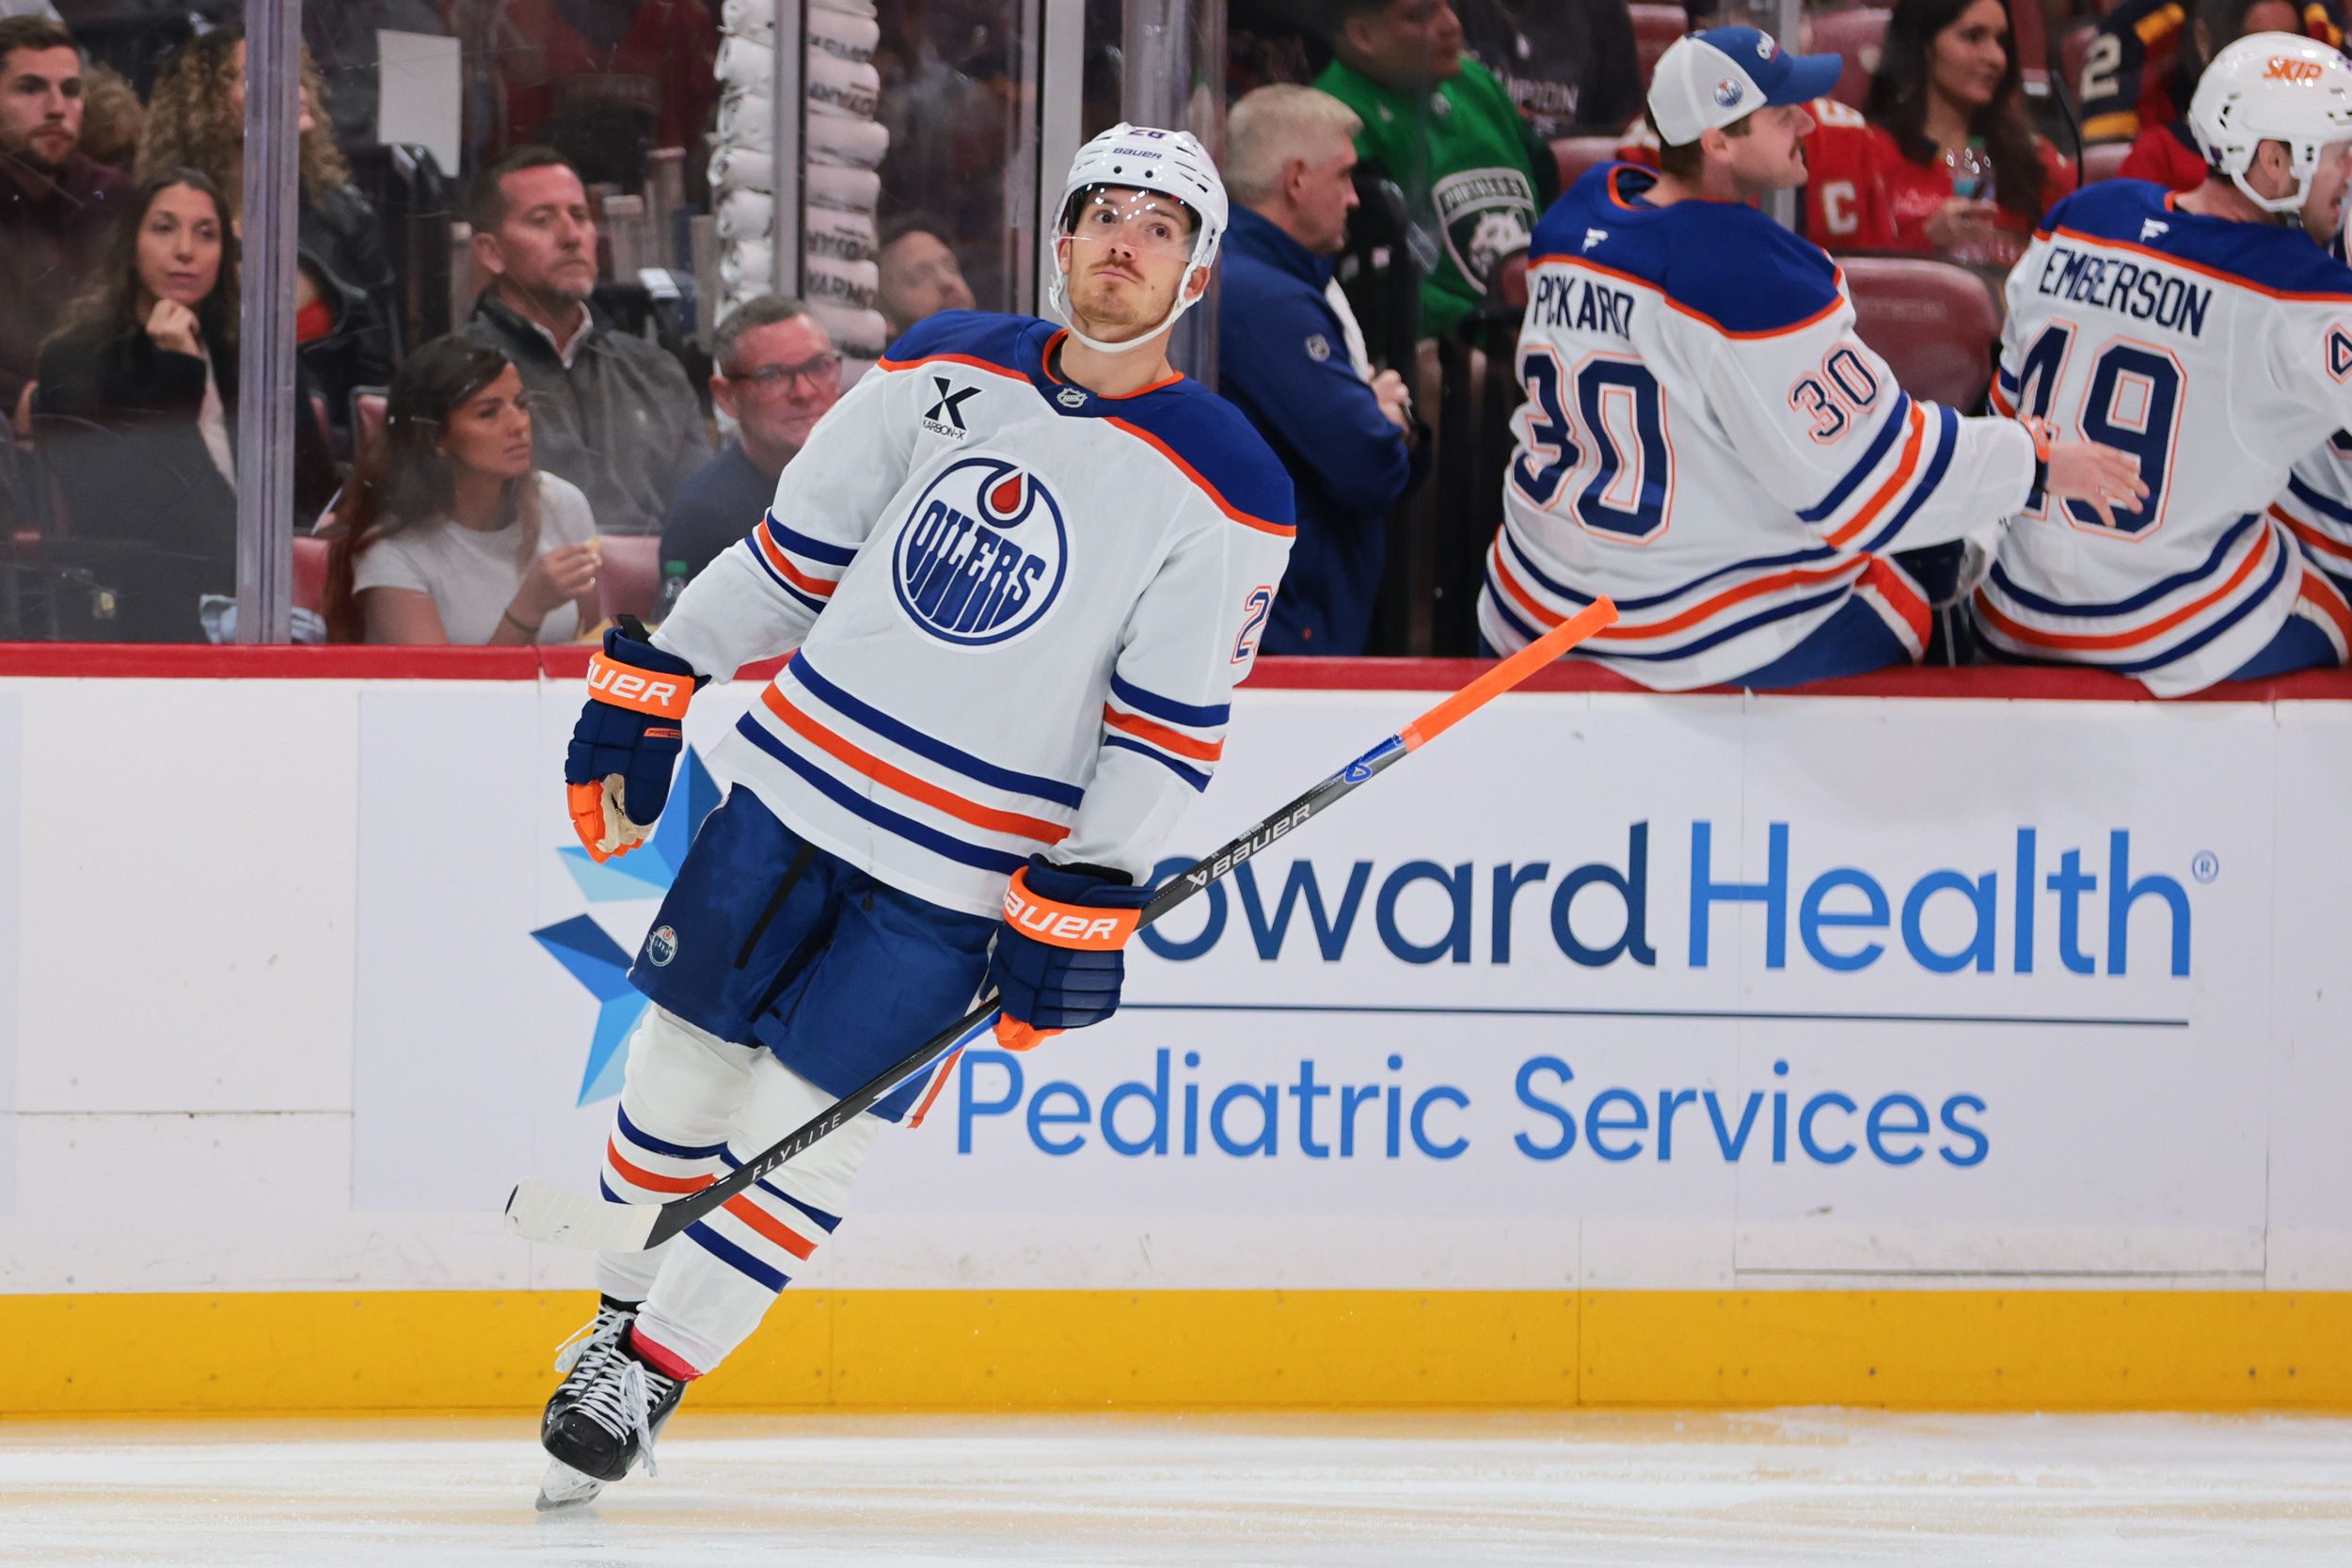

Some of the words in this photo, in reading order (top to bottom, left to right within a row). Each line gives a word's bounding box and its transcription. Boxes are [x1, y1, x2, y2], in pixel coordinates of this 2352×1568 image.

[2263, 56, 2323, 82] SKIP
[1112, 147, 1162, 160] BAUER
[1822, 181, 1860, 234] C
[2039, 247, 2213, 338] EMBERSON
[922, 418, 967, 441] KARBON-X
[1788, 341, 1882, 445] 30
[1510, 345, 1676, 547] 30
[906, 499, 1047, 634] OILERS
[1230, 585, 1279, 664] 2
[587, 657, 677, 706] UER
[1212, 802, 1311, 879] BAUER
[1004, 882, 1119, 941] AUER
[1136, 818, 1657, 968] oward
[1688, 819, 2192, 979] Health
[958, 1046, 1470, 1160] Pediatric
[1513, 1054, 1991, 1168] Services
[751, 1112, 842, 1182] FLYLITE
